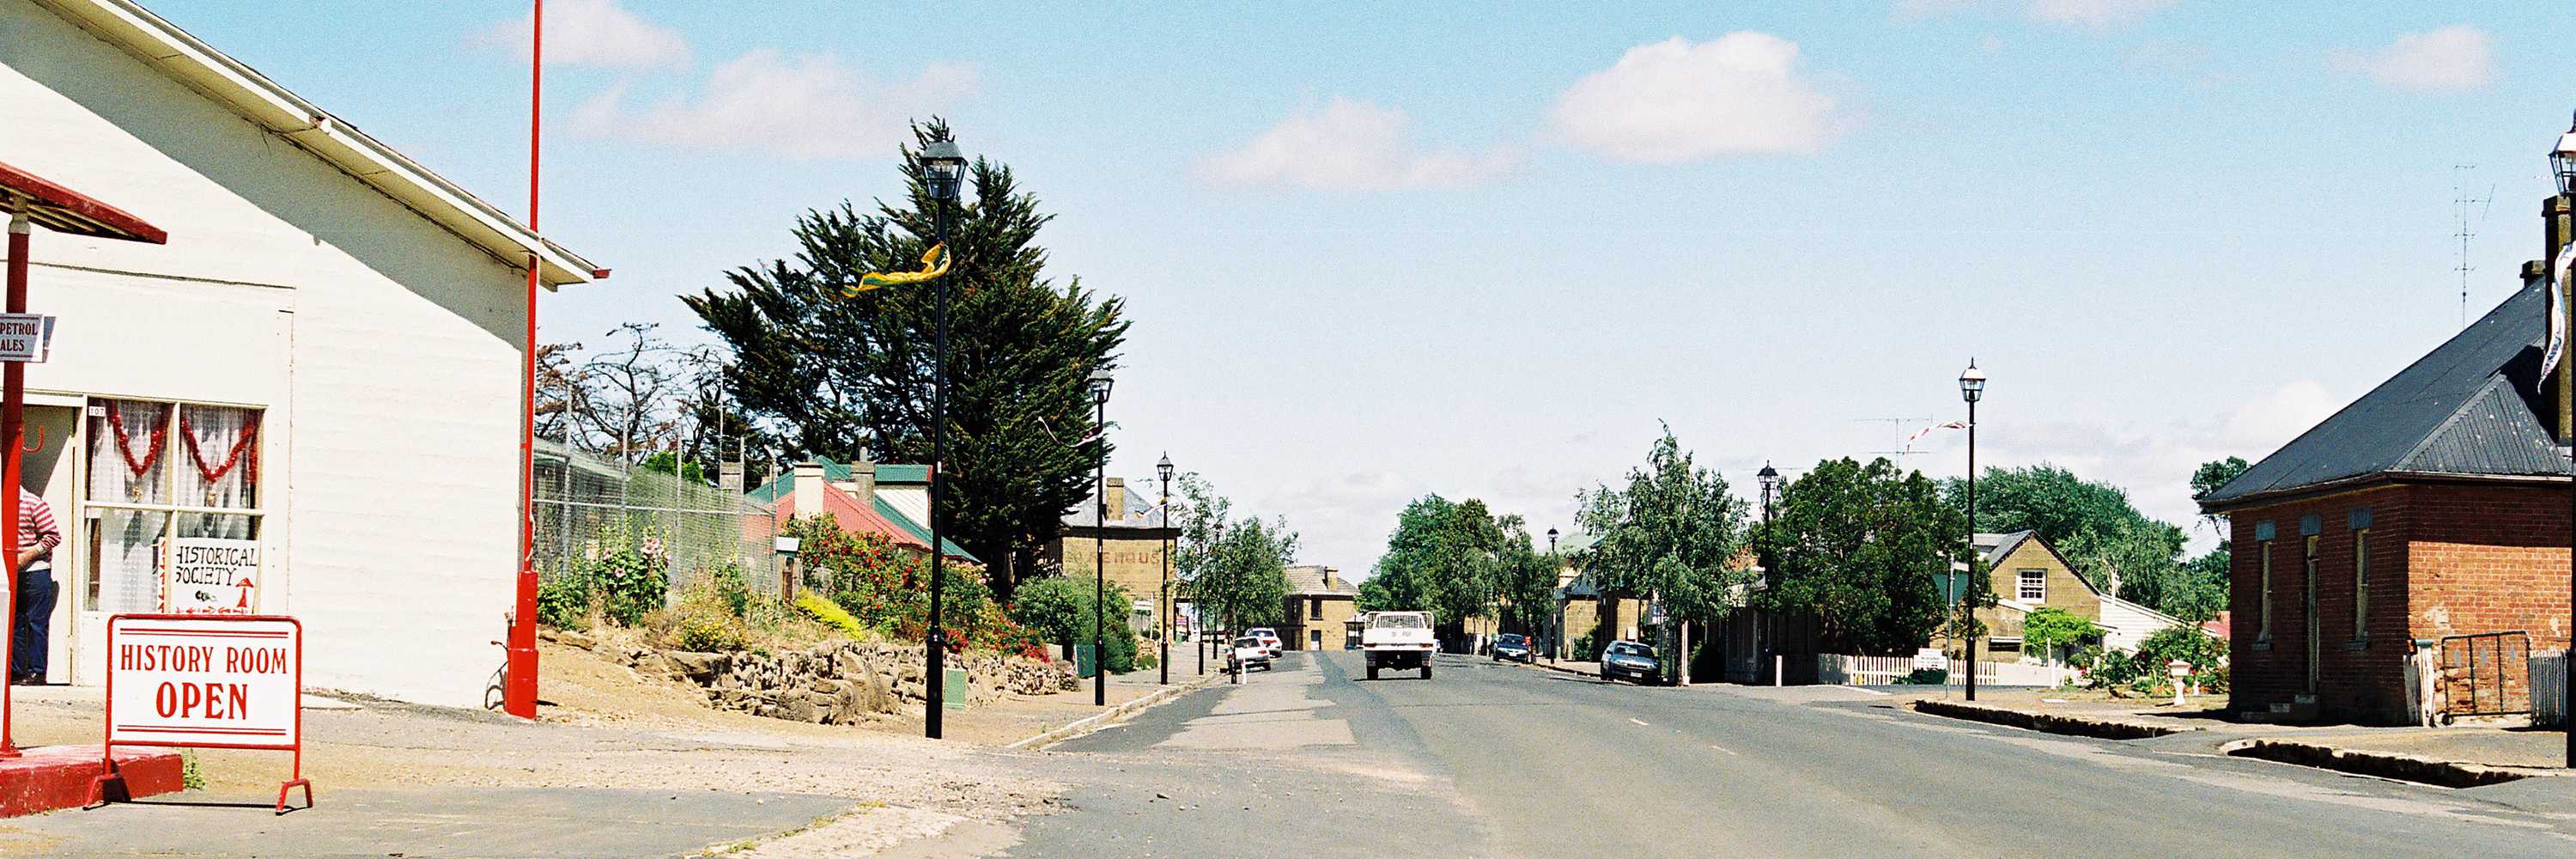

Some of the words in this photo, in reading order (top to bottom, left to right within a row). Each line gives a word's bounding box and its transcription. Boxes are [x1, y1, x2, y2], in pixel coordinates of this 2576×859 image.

[0, 323, 38, 335] PETROL
[0, 339, 24, 351] ALES
[176, 545, 257, 567] HISTORICAL
[176, 566, 237, 586] SOCIETY
[120, 644, 214, 673] HISTORY
[226, 647, 288, 674] ROOM
[155, 681, 248, 720] OPEN
